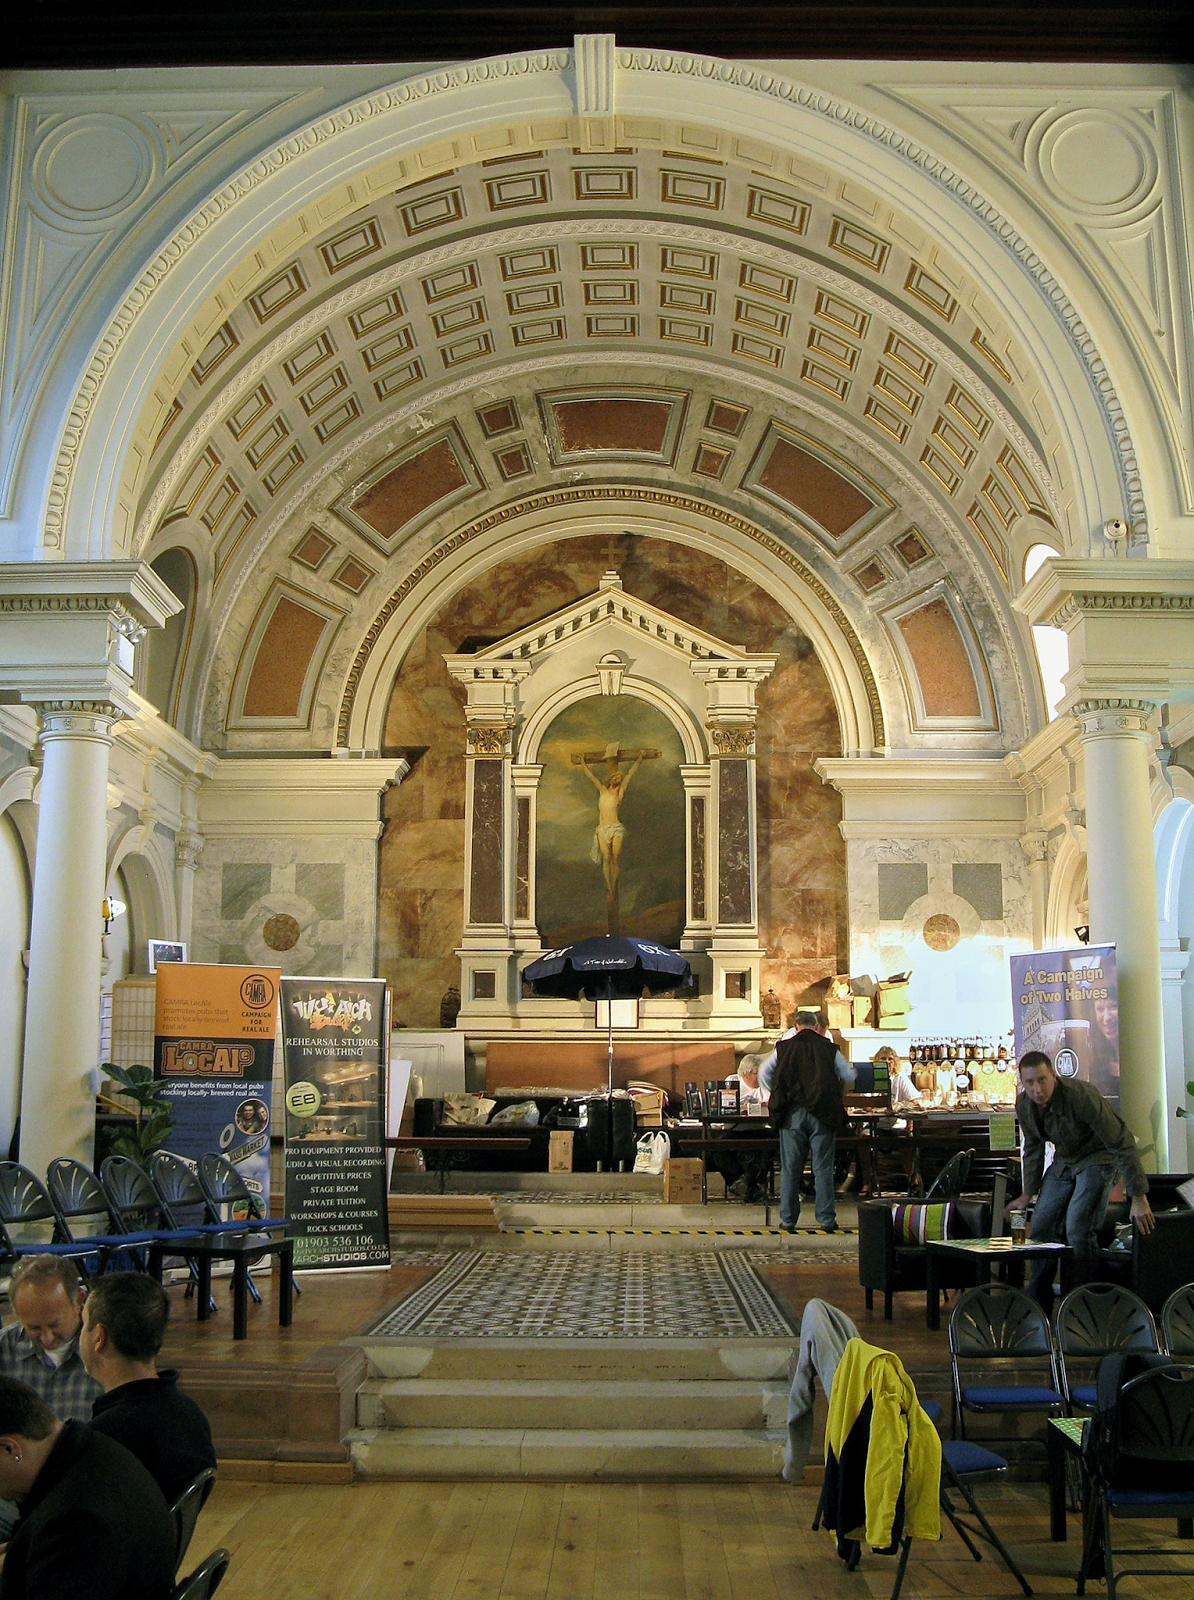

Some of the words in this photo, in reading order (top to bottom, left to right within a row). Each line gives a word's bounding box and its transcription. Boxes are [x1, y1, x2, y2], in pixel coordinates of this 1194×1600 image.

[1023, 971, 1034, 985] A
[1037, 966, 1104, 984] Campaign
[1020, 991, 1034, 1005] of
[1036, 990, 1062, 1004] Two
[1065, 987, 1109, 1002] Halves
[180, 1041, 213, 1051] CAMRA
[286, 1038, 340, 1047] REHEARSAL
[341, 1038, 379, 1047] STUDIOS
[303, 1047, 313, 1056] IN
[315, 1047, 364, 1056] WORTHING
[249, 1083, 264, 1091] pubs
[160, 1090, 187, 1098] stocking
[301, 1147, 344, 1155] EQUIPMENT
[345, 1146, 382, 1154] PROVIDED
[285, 1160, 306, 1168] UDIO
[315, 1159, 342, 1167] VISUAL
[343, 1159, 386, 1167] RECORDING
[295, 1173, 346, 1181] COMPETITIVE
[346, 1171, 373, 1180] PRICES
[310, 1186, 336, 1194] STAGE
[336, 1185, 359, 1193] ROOM
[303, 1199, 335, 1207] PRIVATE
[336, 1198, 367, 1206] TUITION
[290, 1212, 337, 1220] WORKSHOPS
[337, 1211, 344, 1219] &
[345, 1210, 379, 1218] COURSES
[307, 1225, 329, 1233] ROCK
[329, 1224, 364, 1232] SCHOOLS
[297, 1237, 330, 1248] 01903
[332, 1236, 352, 1247] 536
[355, 1235, 374, 1245] 106
